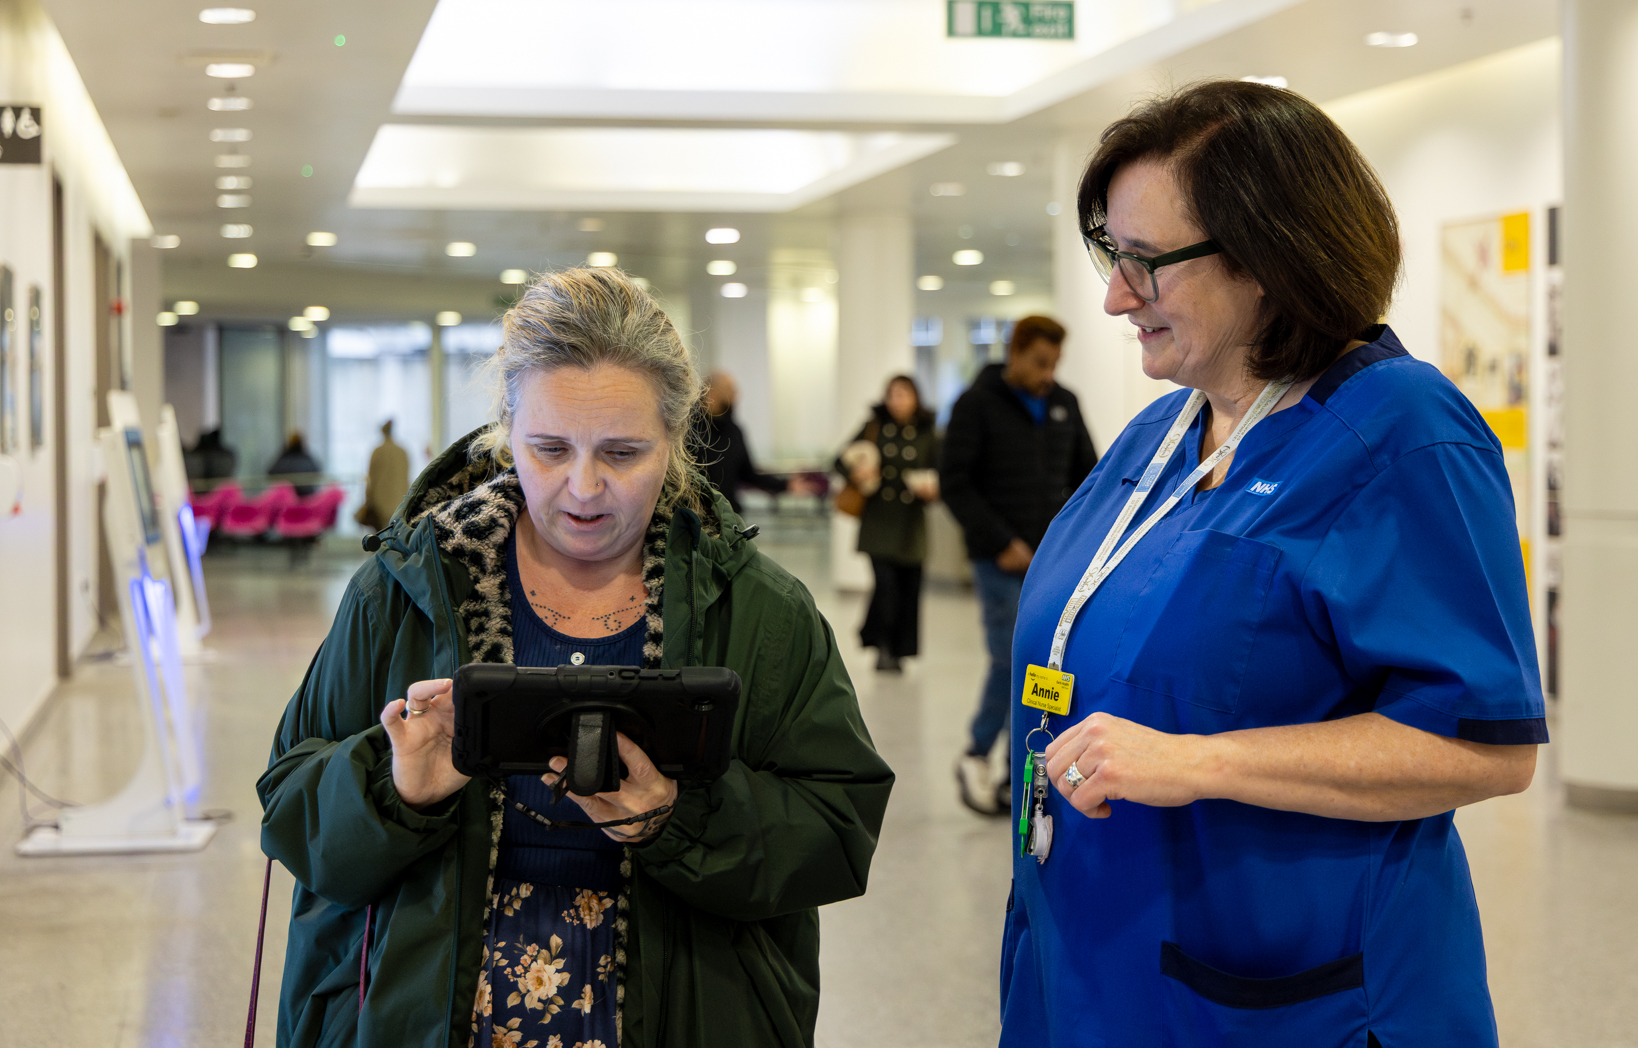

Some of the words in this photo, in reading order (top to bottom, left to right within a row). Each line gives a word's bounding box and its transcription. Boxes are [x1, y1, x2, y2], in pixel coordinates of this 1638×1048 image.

[1250, 480, 1278, 494] NHS
[1031, 682, 1060, 702] Annie
[1026, 697, 1038, 706] Clinical
[1037, 700, 1047, 708] Nurse
[1046, 703, 1062, 712] Specialist
